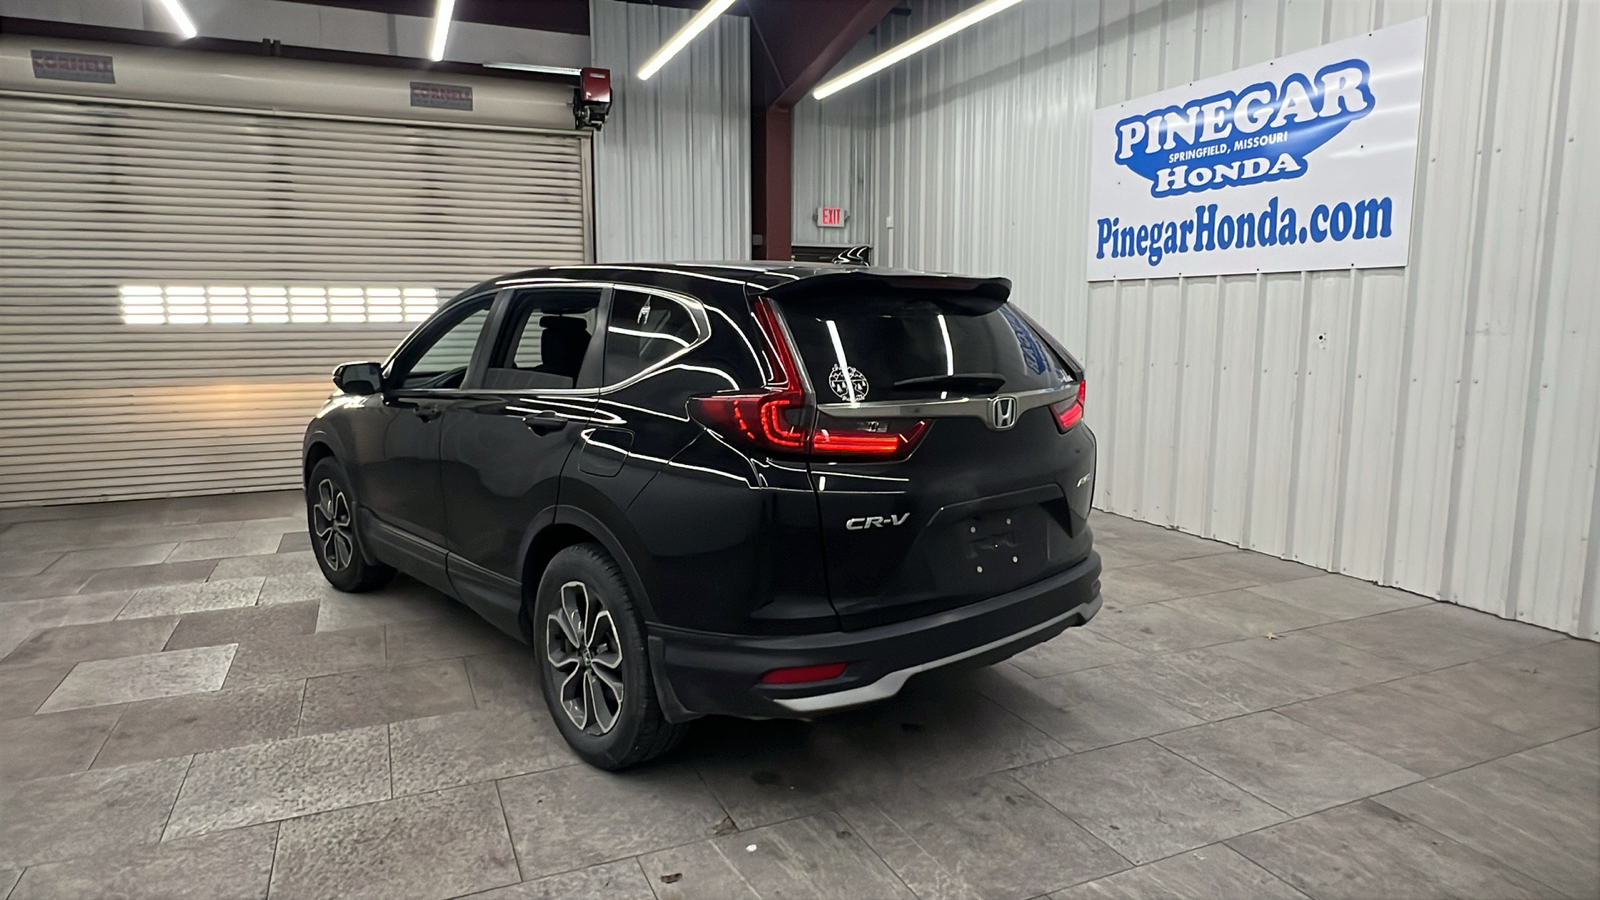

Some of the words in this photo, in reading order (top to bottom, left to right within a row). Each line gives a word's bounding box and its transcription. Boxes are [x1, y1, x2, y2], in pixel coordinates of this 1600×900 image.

[1118, 66, 1368, 160] PINEGAR
[1168, 143, 1231, 163] SPRINGFIELD,
[1234, 131, 1288, 151] MISSOURI
[1155, 153, 1301, 192] HONDA
[822, 208, 841, 225] EXIT
[1096, 196, 1392, 266] PinegarHonda.com
[846, 513, 910, 530] CR-V
